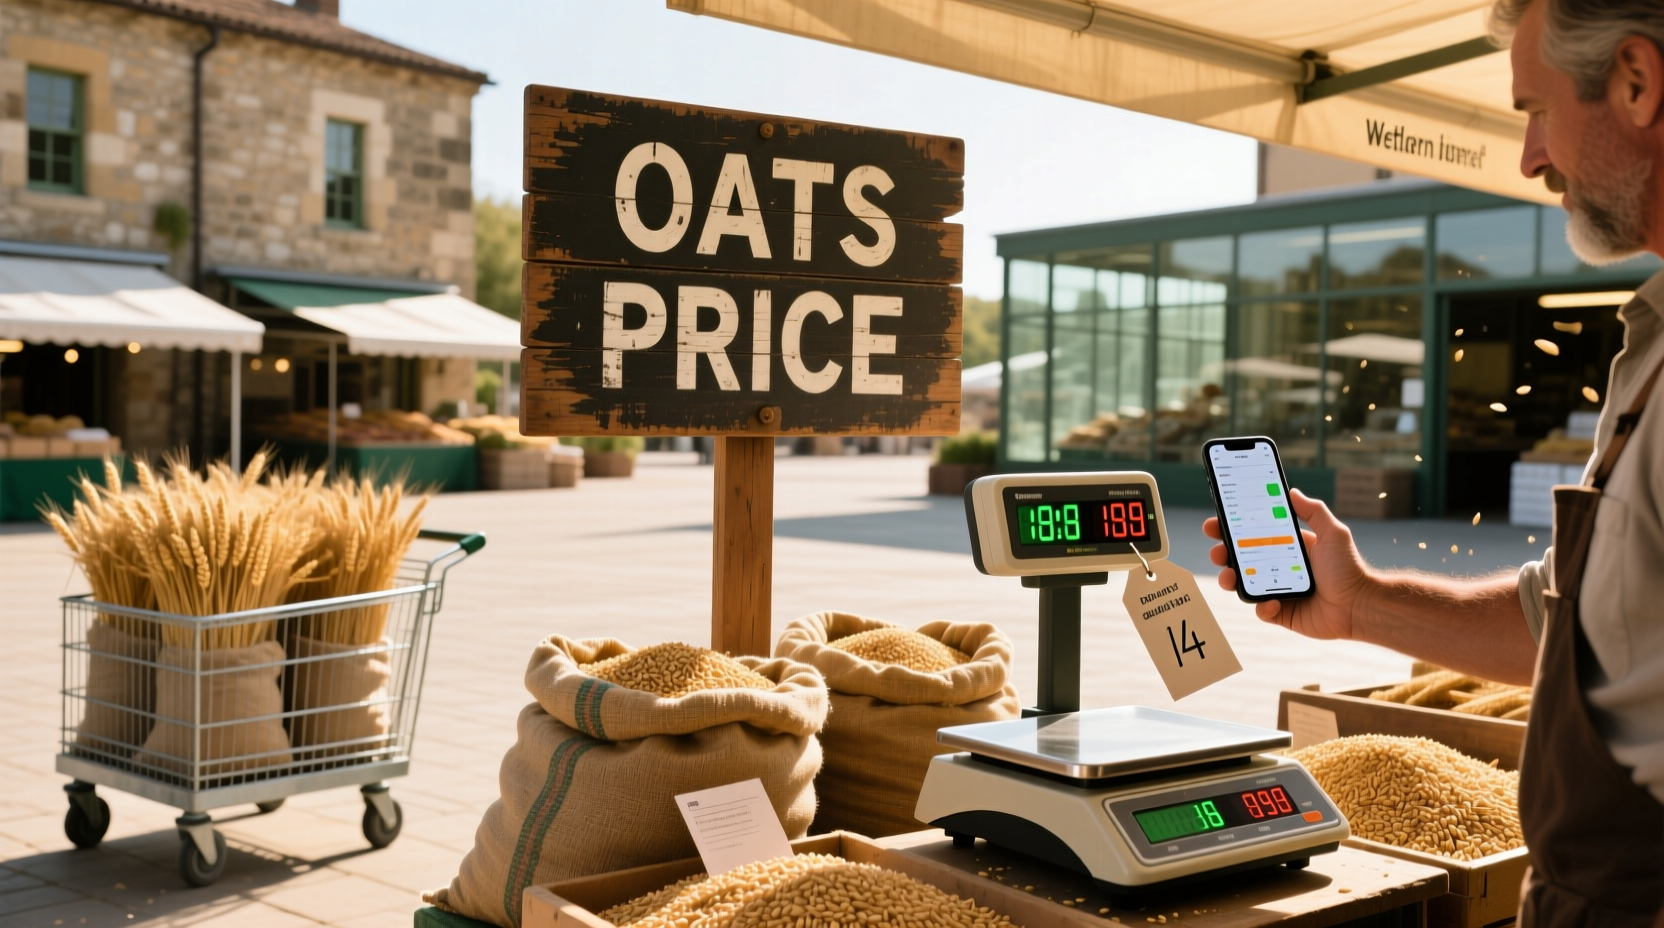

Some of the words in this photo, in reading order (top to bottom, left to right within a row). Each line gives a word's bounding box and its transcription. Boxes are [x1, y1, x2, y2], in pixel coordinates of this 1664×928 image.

[615, 141, 896, 268] OATS
[602, 281, 904, 395] PRICE
[1166, 619, 1206, 668] 14
